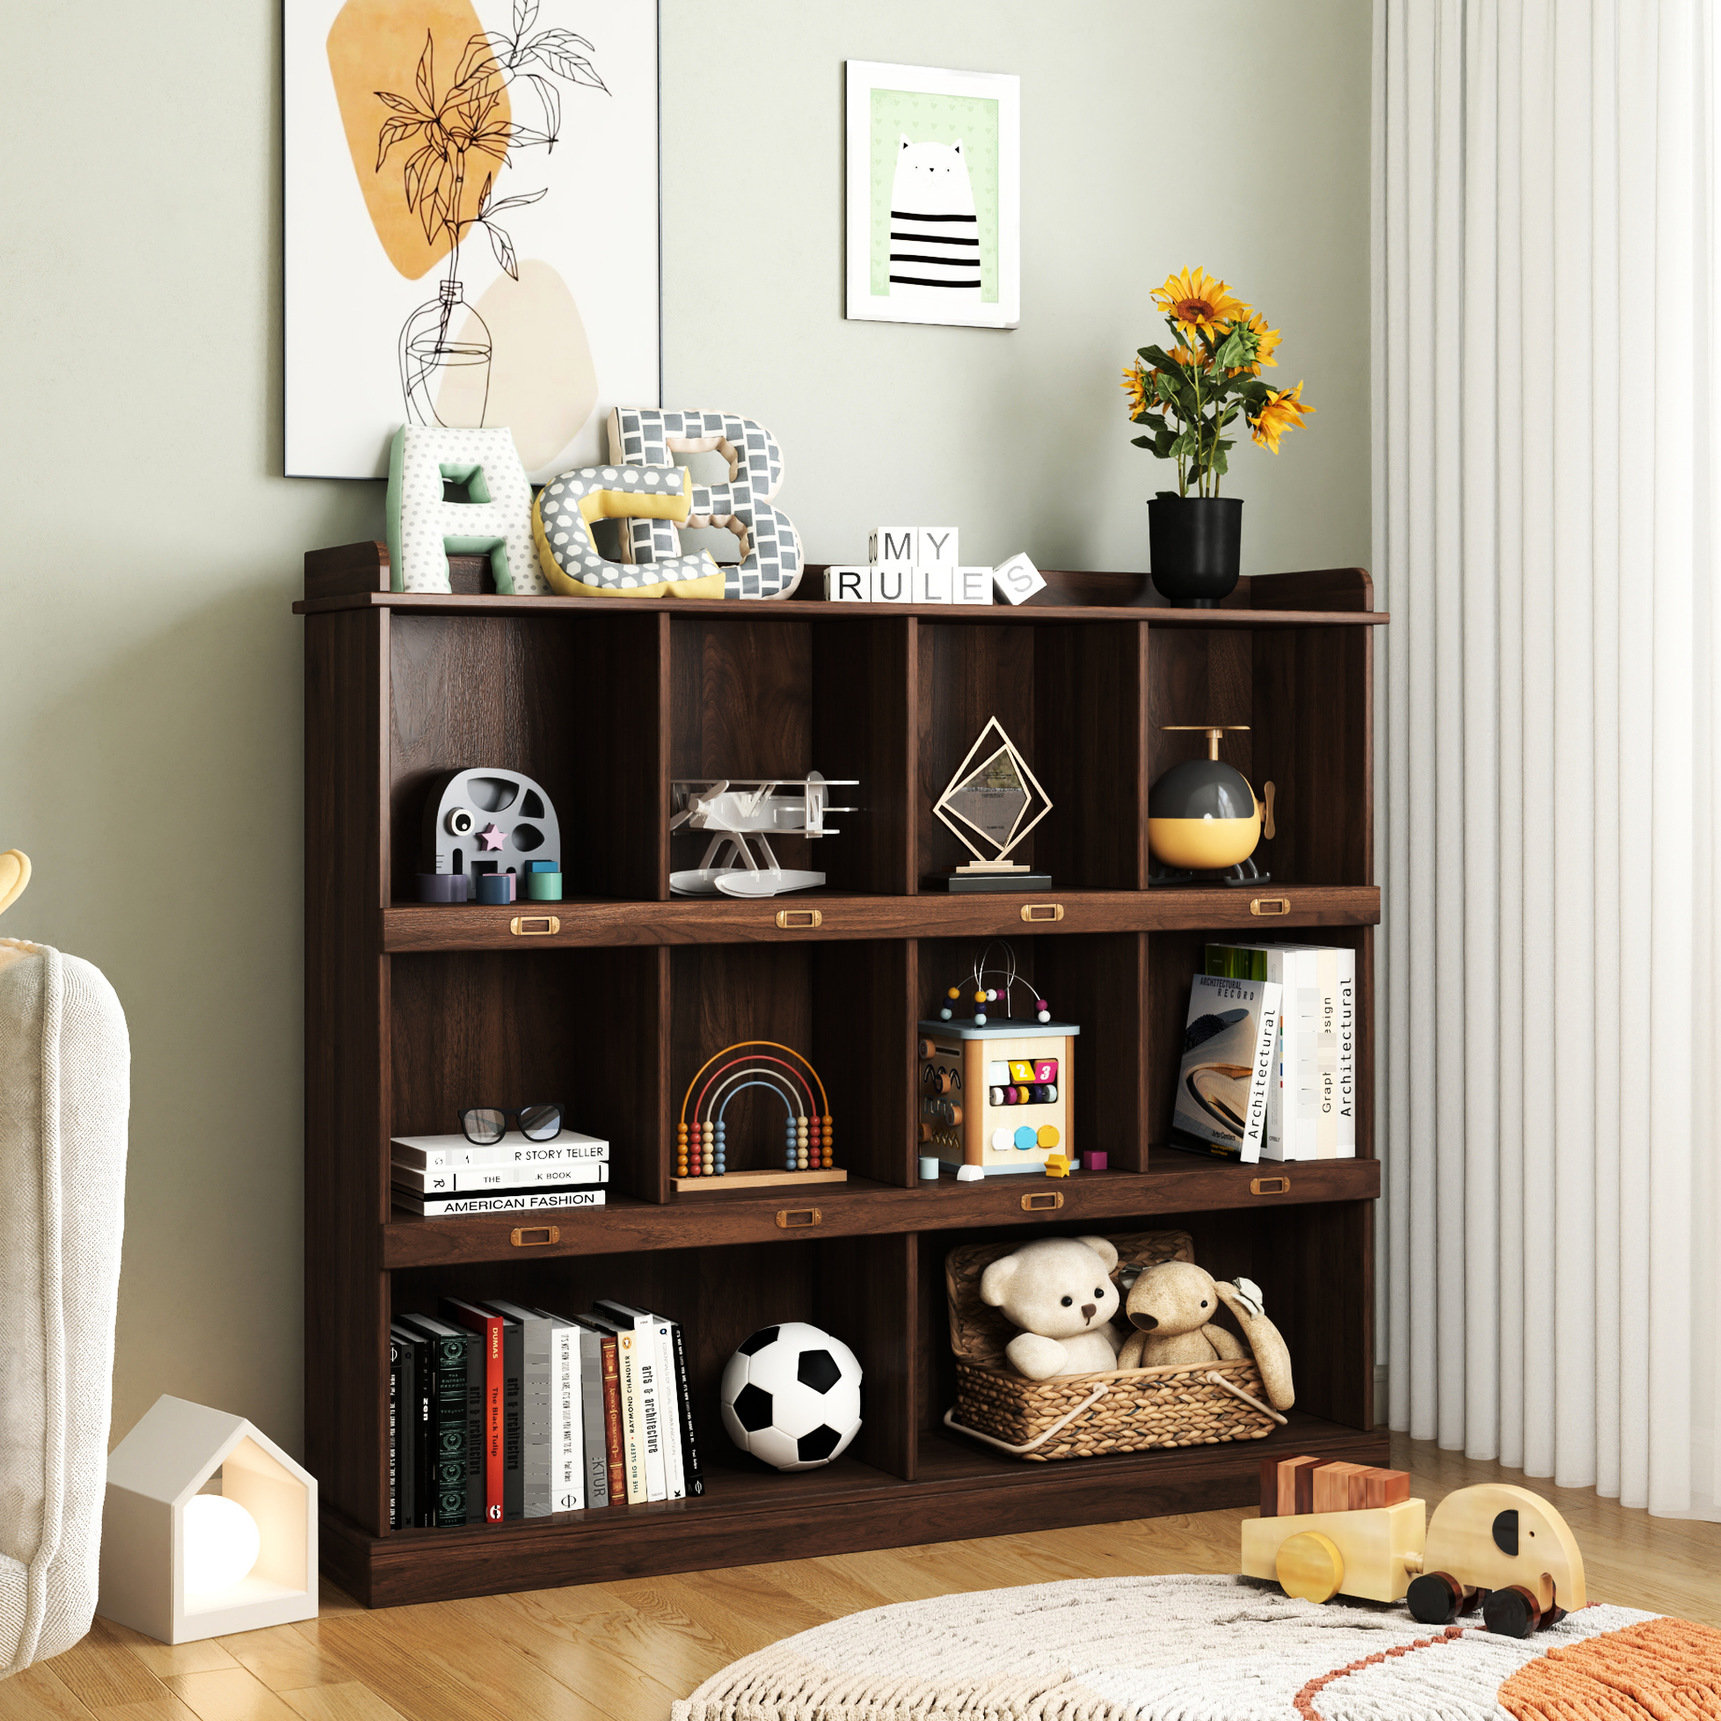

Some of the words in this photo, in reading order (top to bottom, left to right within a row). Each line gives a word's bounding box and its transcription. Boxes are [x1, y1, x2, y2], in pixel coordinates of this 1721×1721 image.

[387, 424, 552, 595] A
[885, 533, 950, 560] MY
[839, 566, 1033, 600] RULES
[1200, 977, 1242, 990] ARCHITECTURAL
[1217, 989, 1254, 1000] RECORD
[1340, 978, 1352, 1116] Architectural
[1016, 1064, 1028, 1078] 2
[1040, 1065, 1051, 1080] 3
[1248, 1010, 1275, 1139] Architectural
[526, 1150, 562, 1161] STORY
[567, 1147, 604, 1158] TELLER
[535, 1173, 544, 1181] K
[546, 1172, 572, 1180] BOOK
[444, 1198, 525, 1212] AMERICAN
[530, 1194, 595, 1207] FASHION
[624, 1356, 632, 1393] CHANDLER
[642, 1366, 653, 1384] arts
[627, 1396, 635, 1433] RAYMOND
[645, 1398, 658, 1453] architecture
[592, 1457, 606, 1497] KTUR
